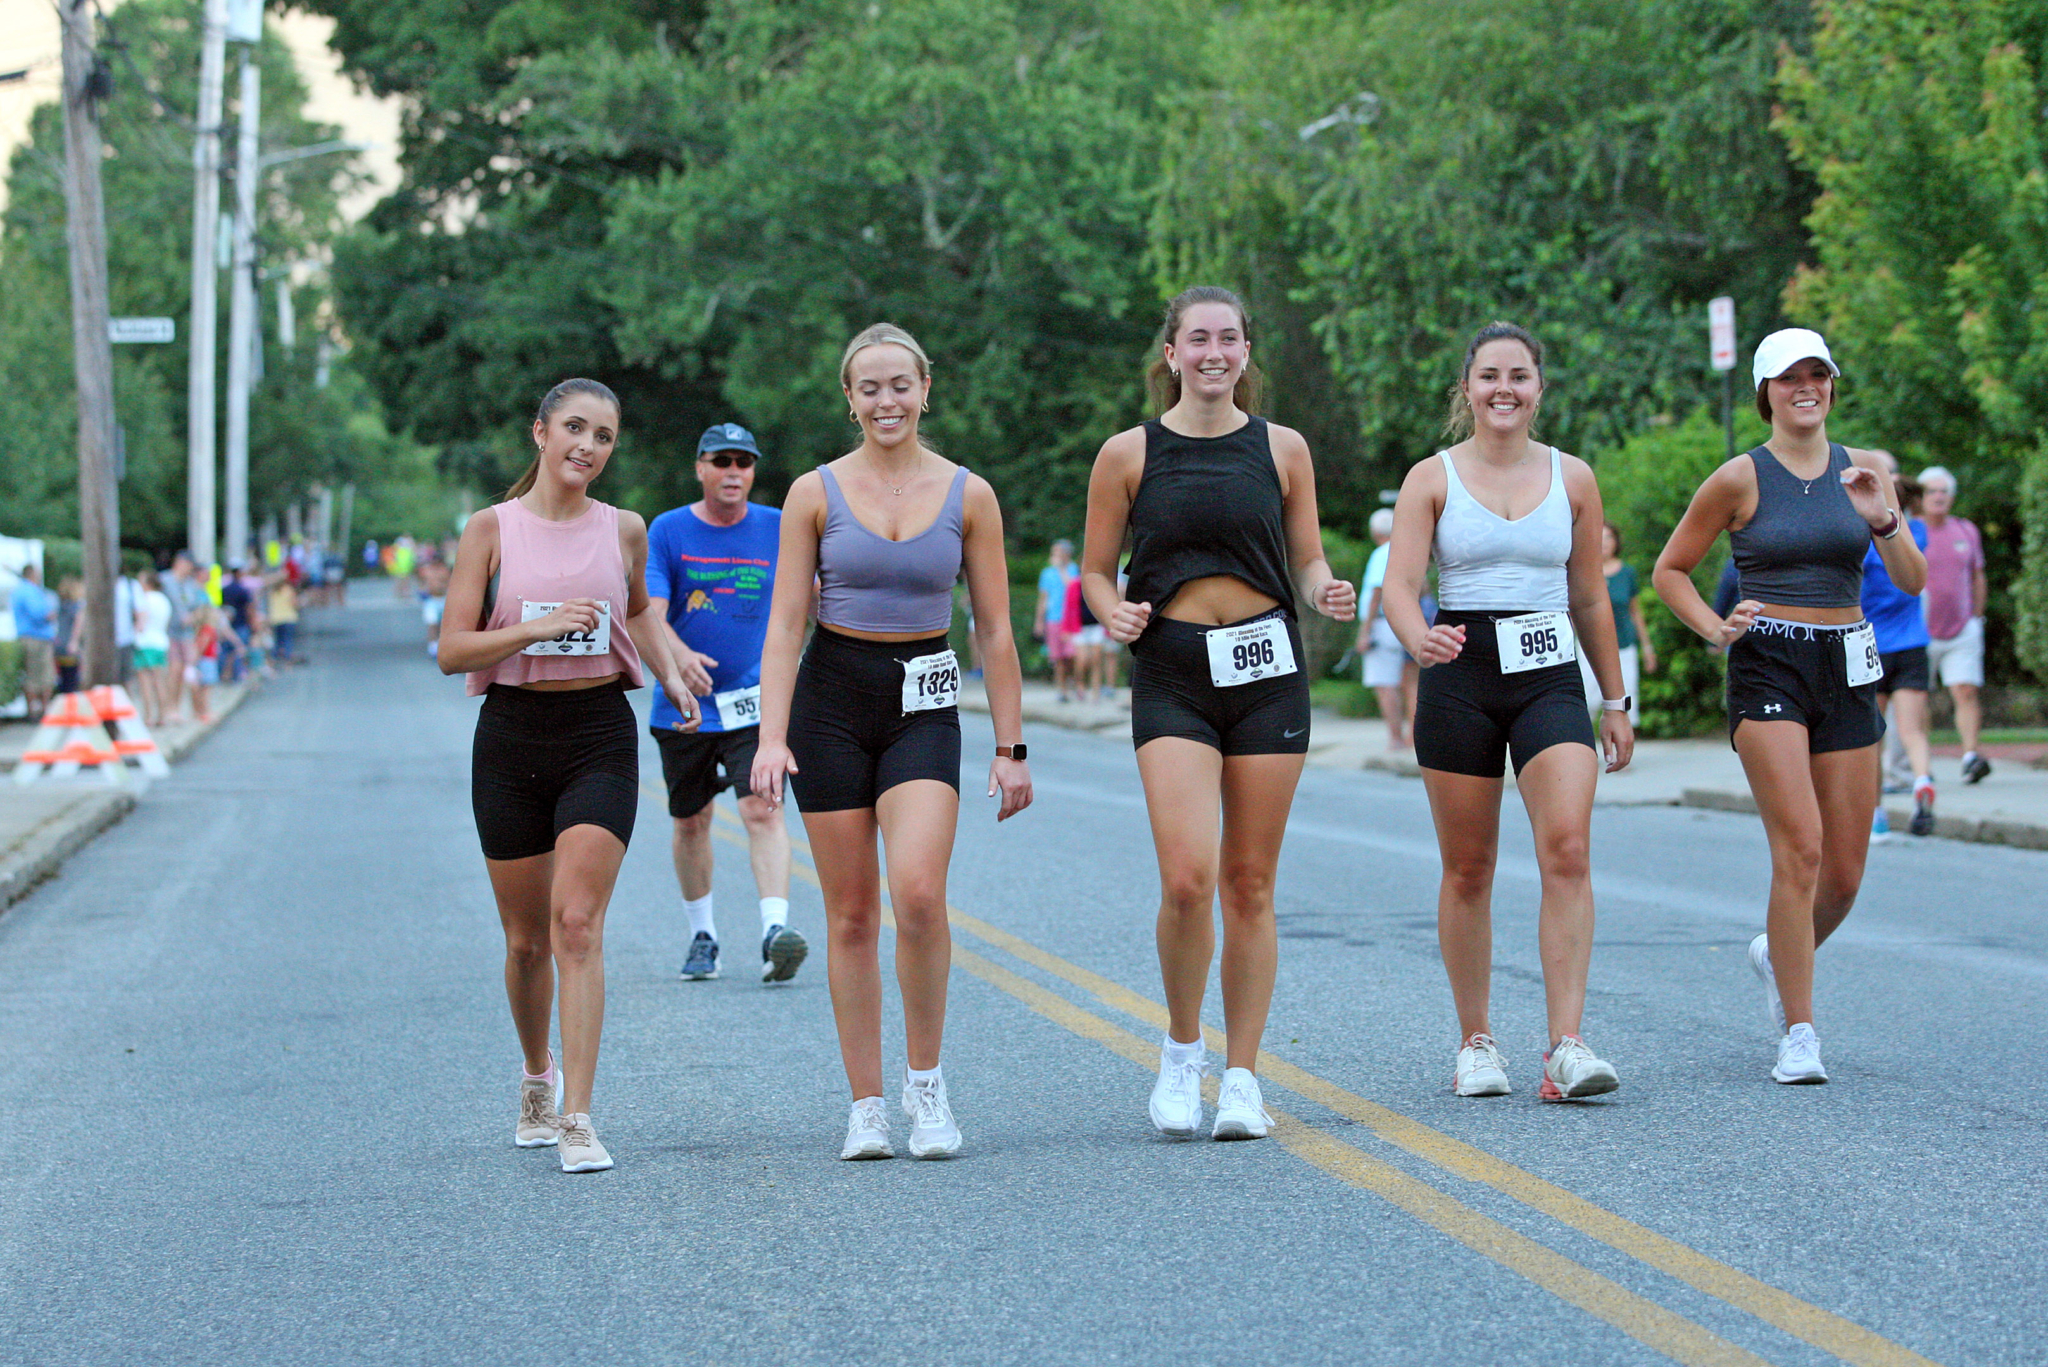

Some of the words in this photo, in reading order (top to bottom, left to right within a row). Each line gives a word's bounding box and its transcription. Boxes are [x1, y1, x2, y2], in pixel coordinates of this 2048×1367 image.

[753, 558, 770, 567] Club
[1233, 639, 1274, 670] 996
[1520, 628, 1558, 656] 995
[917, 666, 957, 696] 1329
